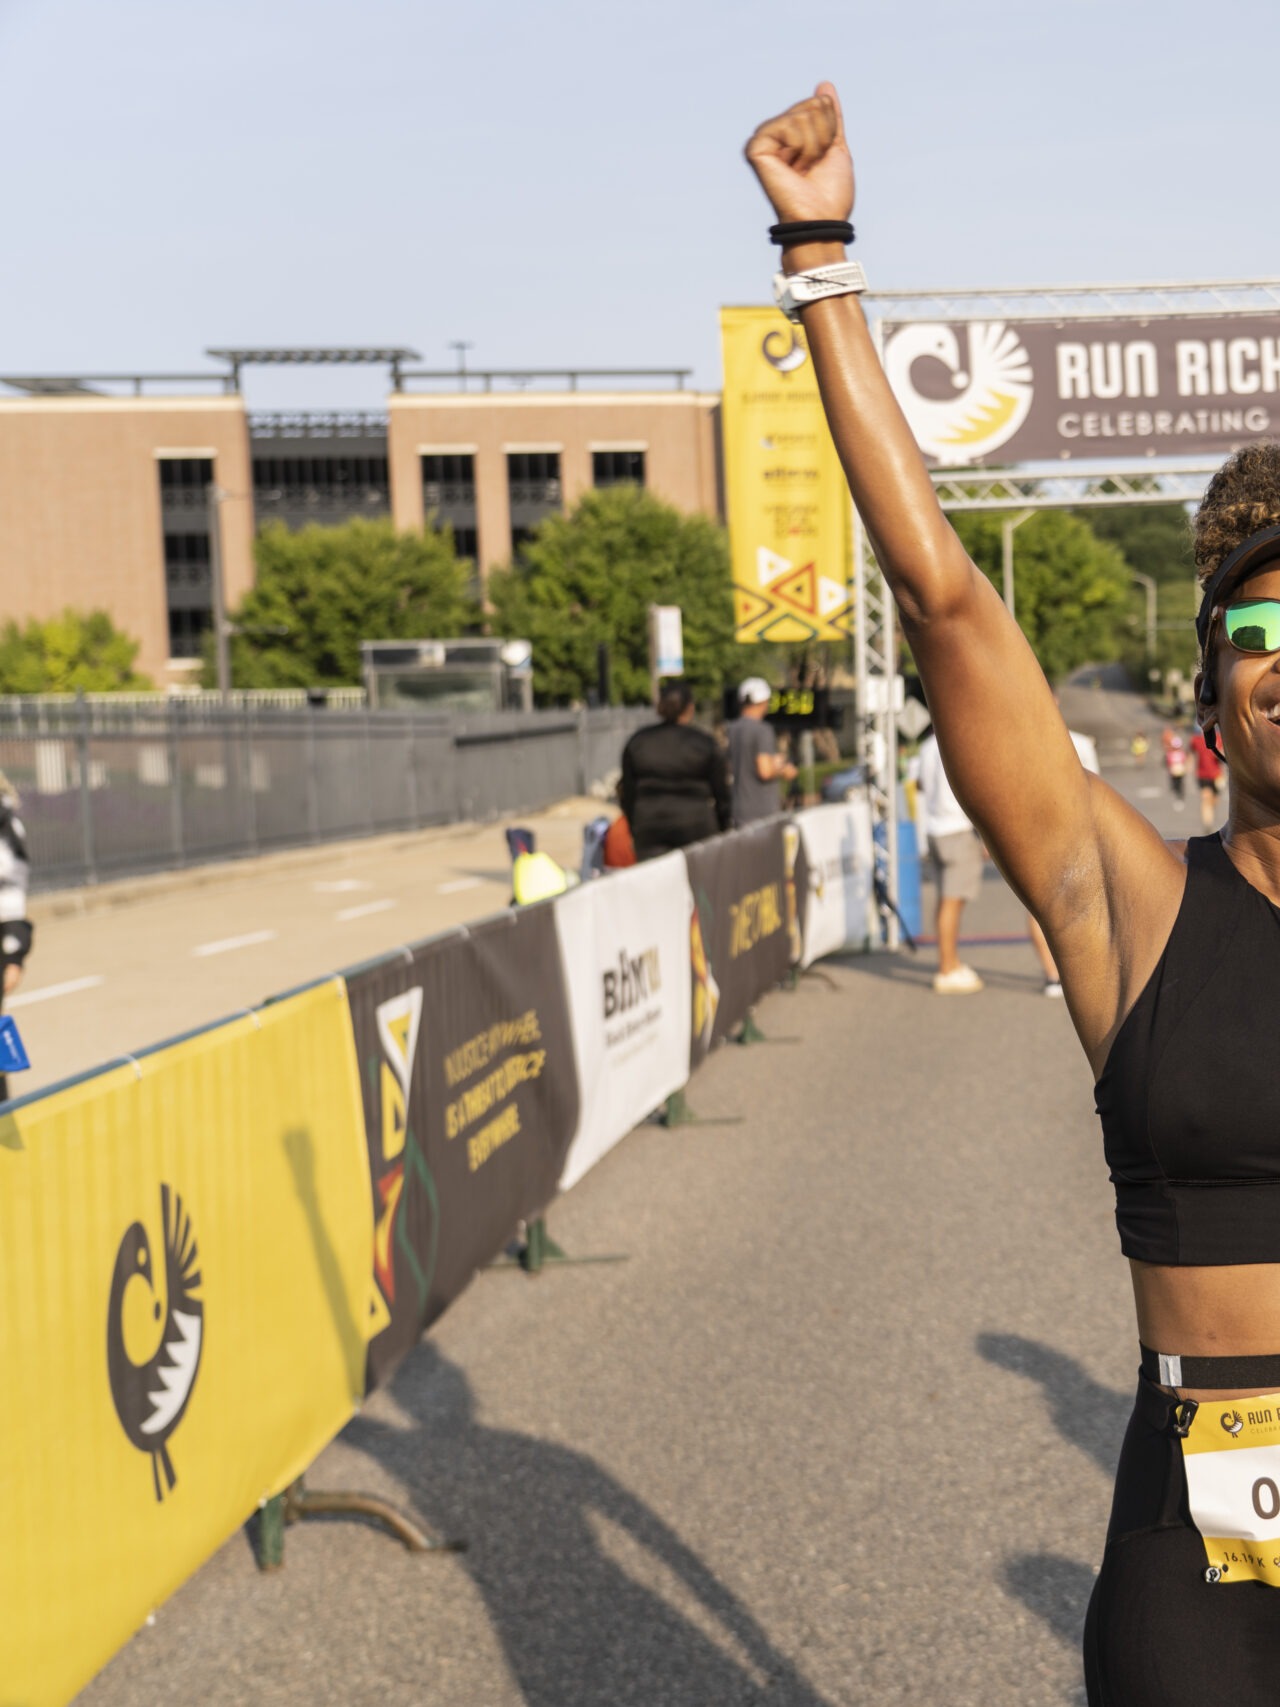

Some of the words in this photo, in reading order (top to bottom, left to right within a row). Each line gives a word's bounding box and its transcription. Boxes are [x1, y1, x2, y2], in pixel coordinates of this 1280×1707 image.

[1056, 341, 1160, 399] RUN
[1057, 407, 1271, 438] CELEBRATING
[1247, 1409, 1272, 1425] RUN
[1223, 1551, 1254, 1565] 16.19
[1257, 1557, 1266, 1568] K
